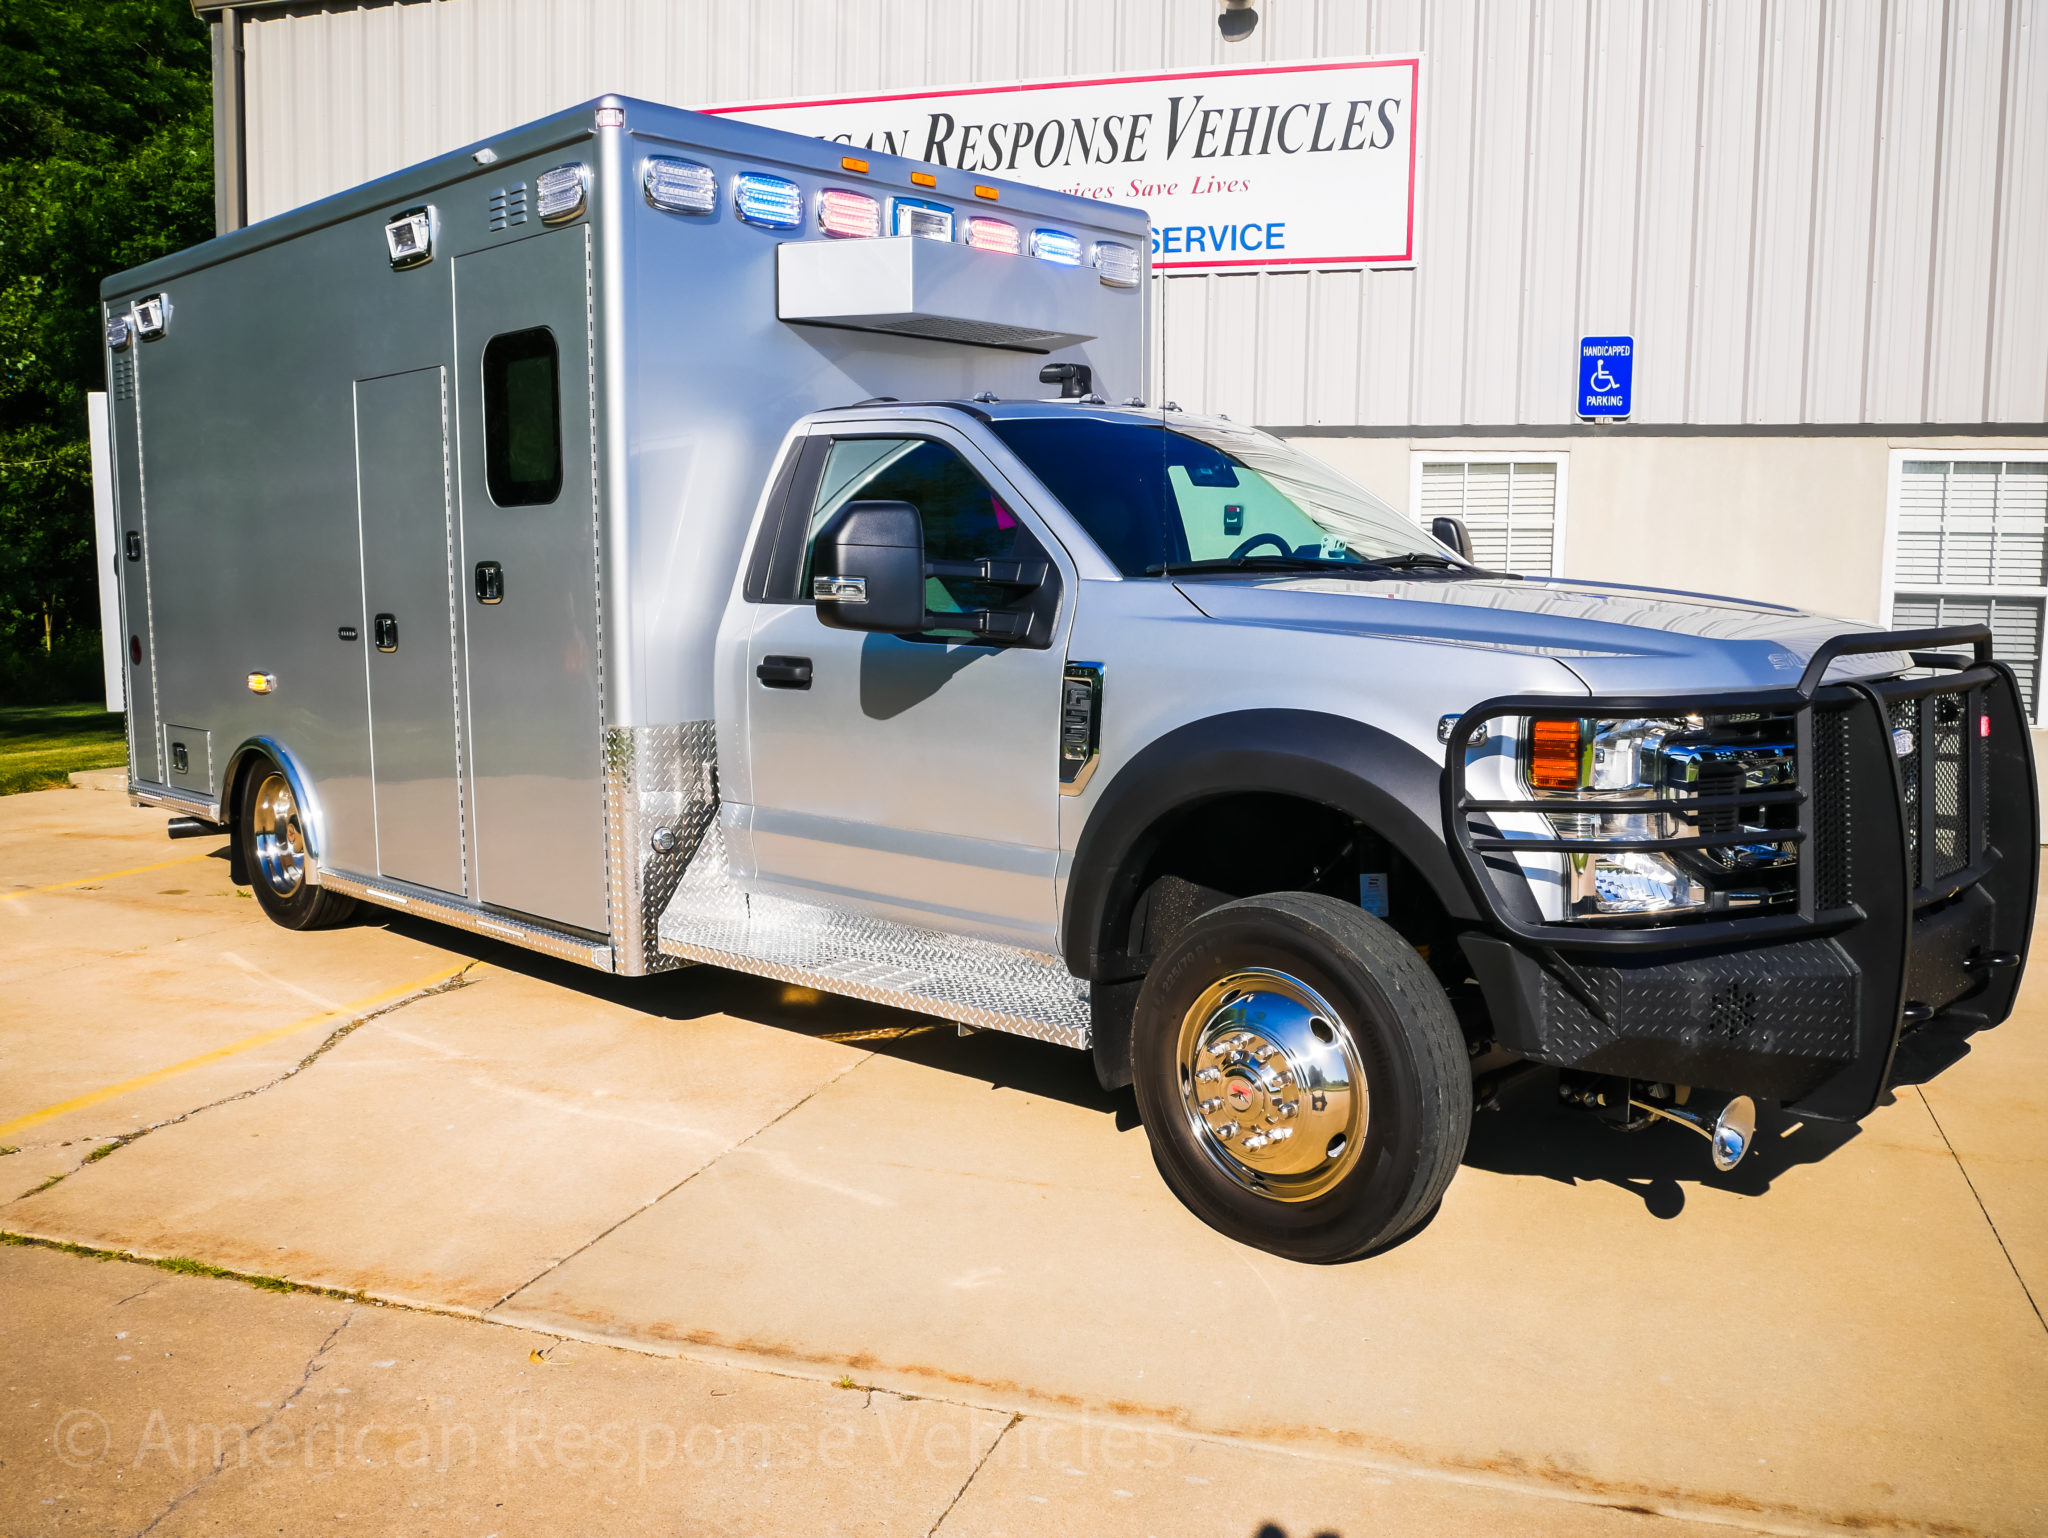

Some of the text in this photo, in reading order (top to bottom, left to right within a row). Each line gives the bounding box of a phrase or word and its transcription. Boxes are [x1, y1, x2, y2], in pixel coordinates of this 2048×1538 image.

[1126, 178, 1179, 198] Save
[1191, 174, 1251, 195] Lives
[1583, 345, 1631, 357] HANDICAPPED
[1586, 395, 1623, 407] PARKING
